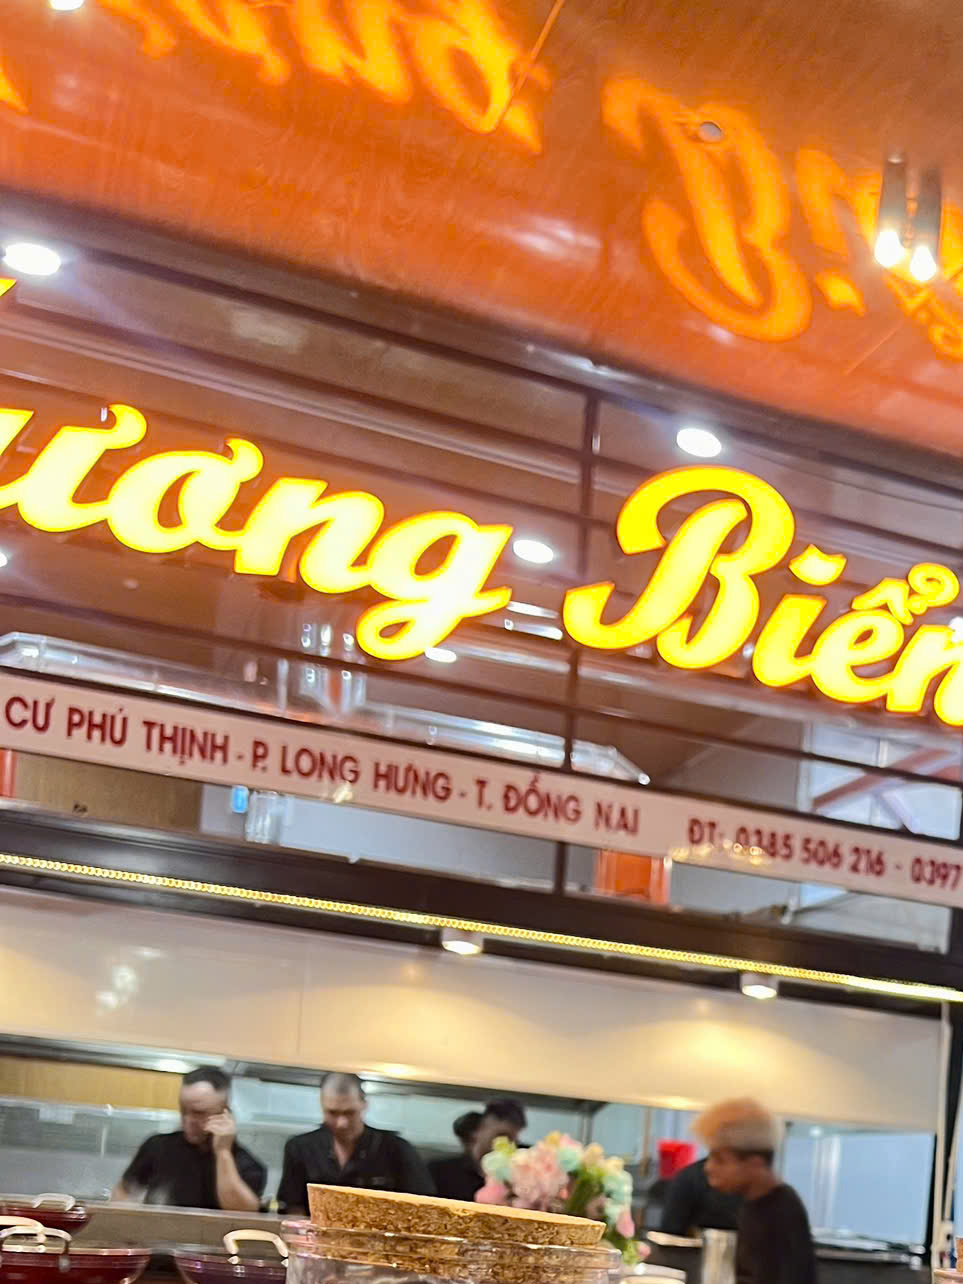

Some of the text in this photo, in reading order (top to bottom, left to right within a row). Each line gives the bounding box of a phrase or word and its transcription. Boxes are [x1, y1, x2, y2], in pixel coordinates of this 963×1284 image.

[5, 696, 55, 732] CƯ
[66, 706, 128, 747] PHÚ
[142, 719, 230, 766] THỊNH
[280, 745, 360, 784] LONG
[373, 760, 451, 801] HƯNG
[594, 801, 640, 836] NAI
[802, 836, 842, 869] 506
[851, 846, 885, 877] 216
